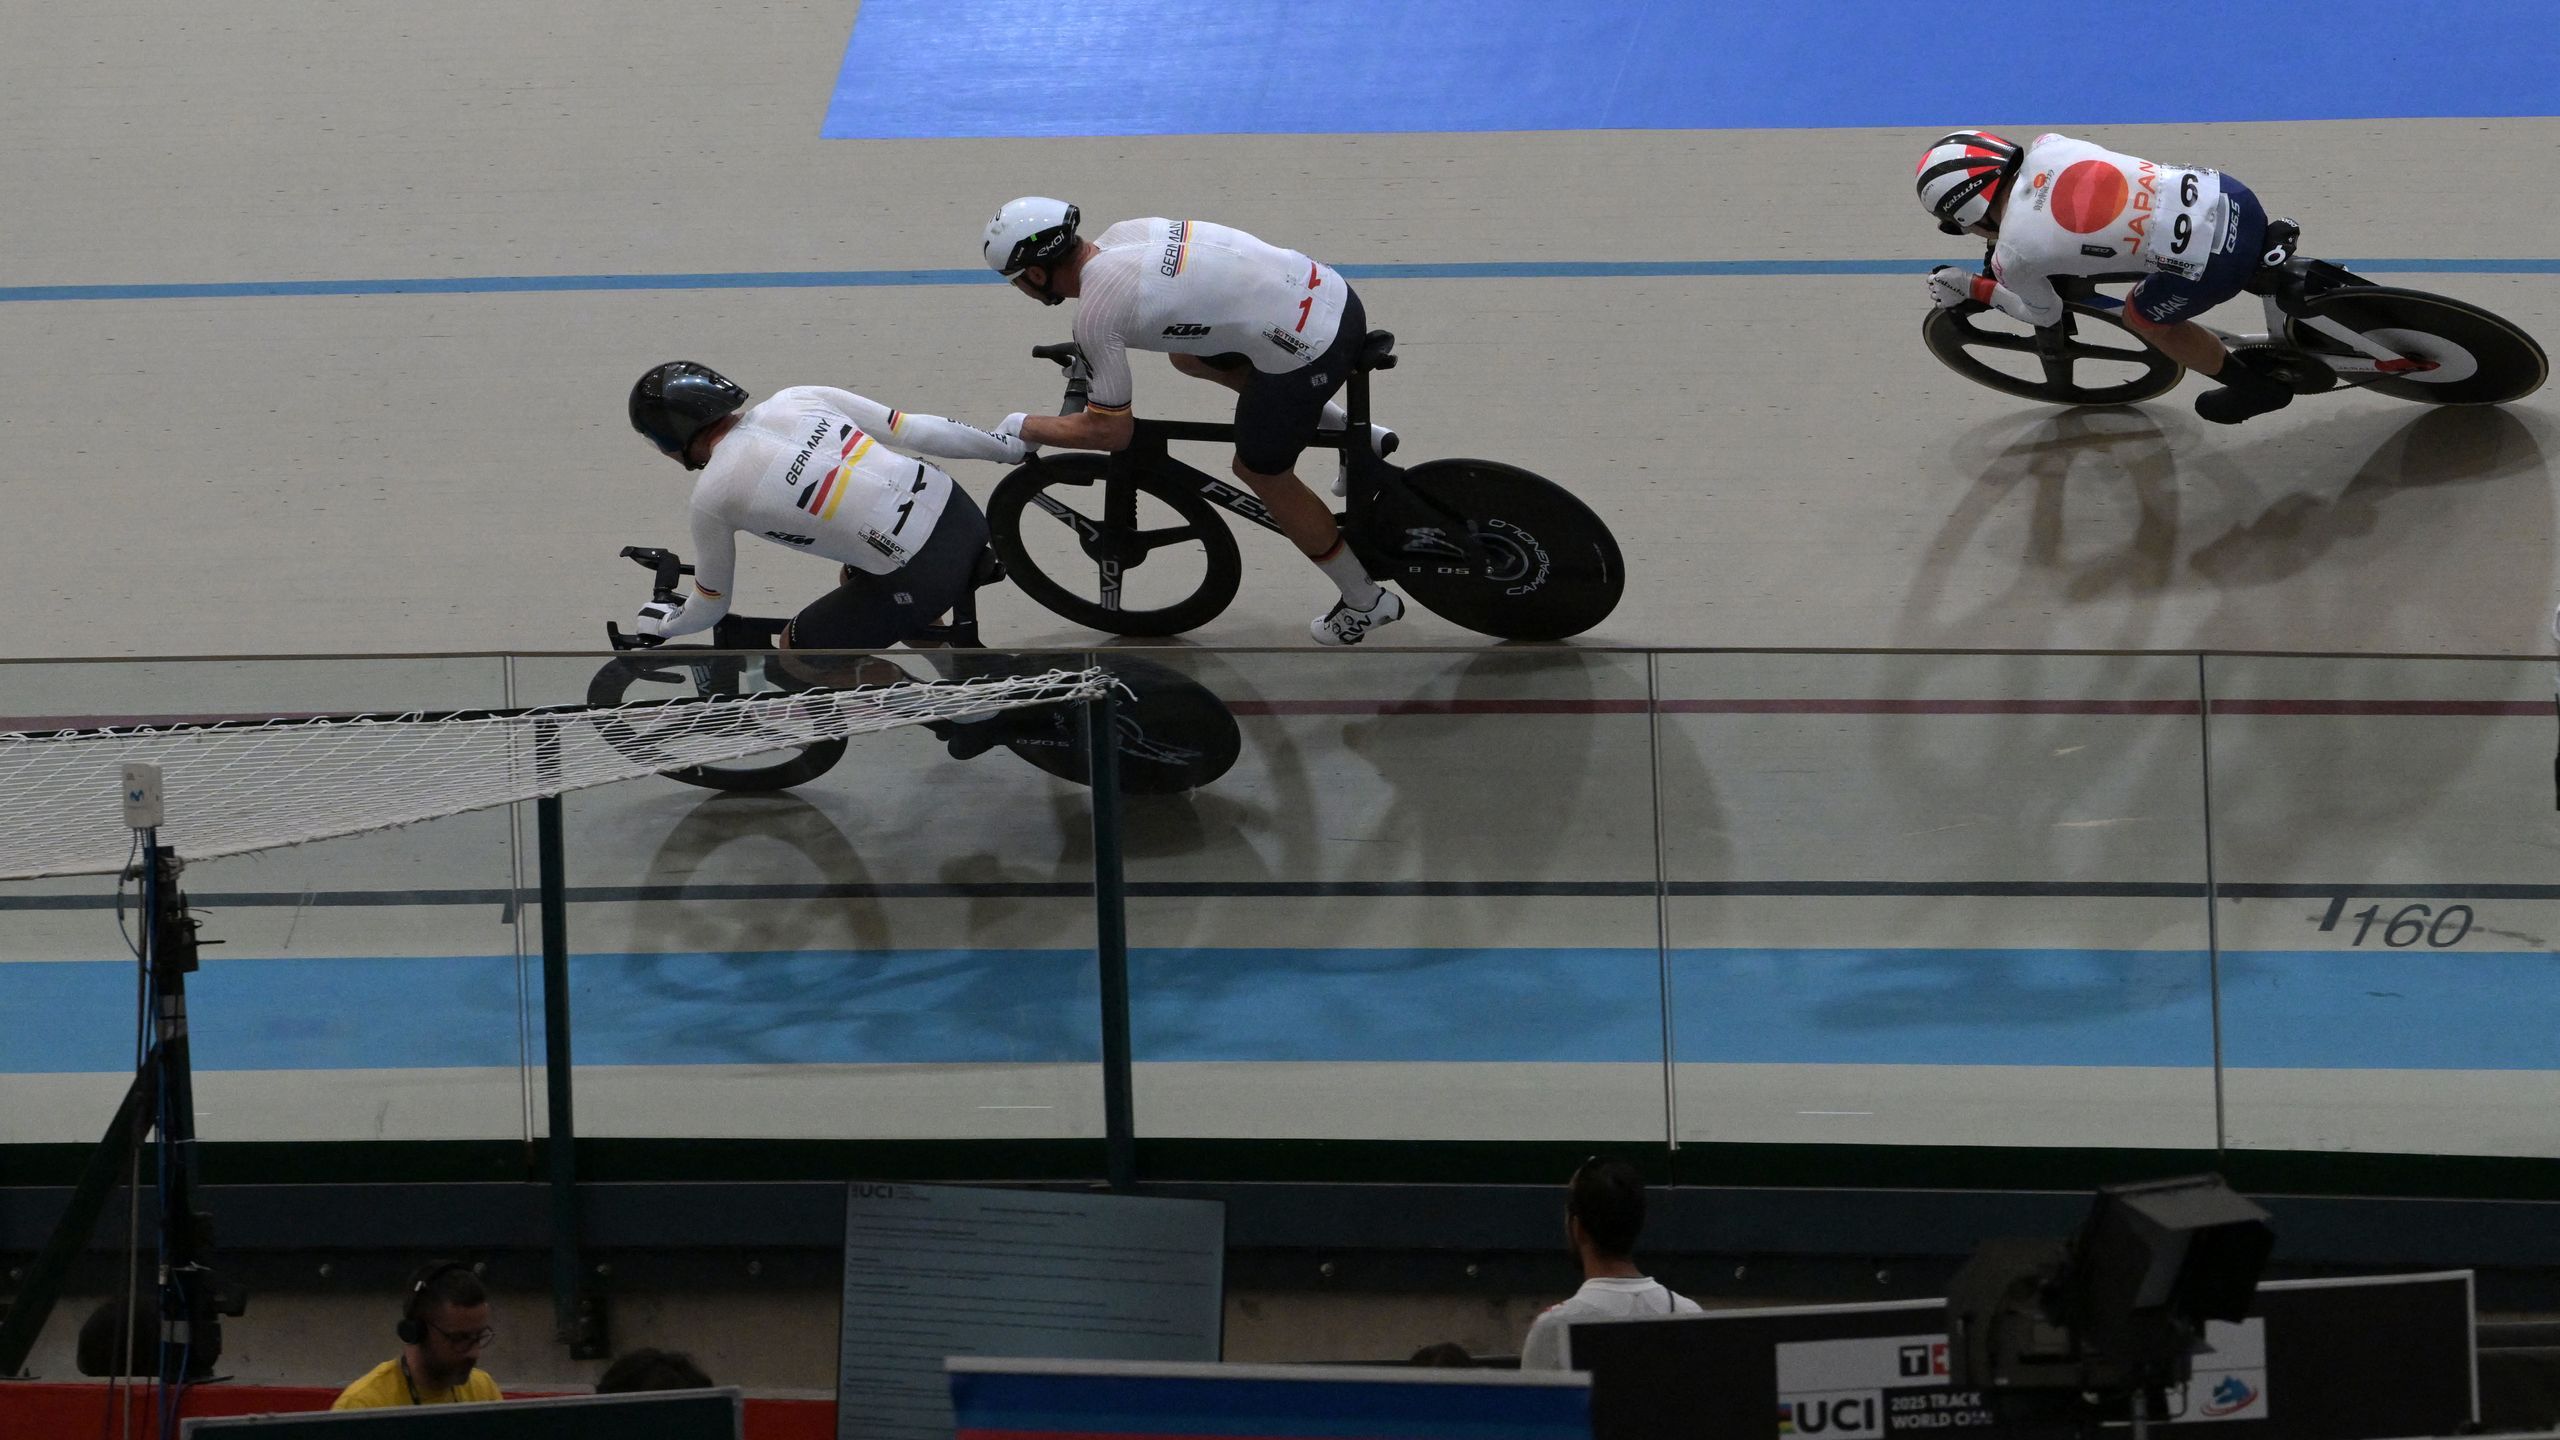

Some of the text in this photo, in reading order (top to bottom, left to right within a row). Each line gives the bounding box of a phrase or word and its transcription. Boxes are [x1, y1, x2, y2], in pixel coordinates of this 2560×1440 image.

[1942, 177, 1984, 212] Kabuto
[2180, 173, 2199, 208] 6
[2123, 160, 2157, 257] JAPAN
[2170, 213, 2193, 255] 9
[1161, 323, 1213, 336] KTM
[1295, 296, 1314, 334] 1
[1284, 333, 1310, 352] TISSOT
[785, 418, 832, 486] GERMANY
[892, 499, 915, 537] 1
[880, 535, 906, 555] TISSOT
[2351, 903, 2475, 949] 160
[858, 1183, 893, 1199] UCI
[1795, 1396, 1876, 1434] UCI
[1928, 1391, 1982, 1409] TRACK
[1890, 1411, 1952, 1431] WORLD
